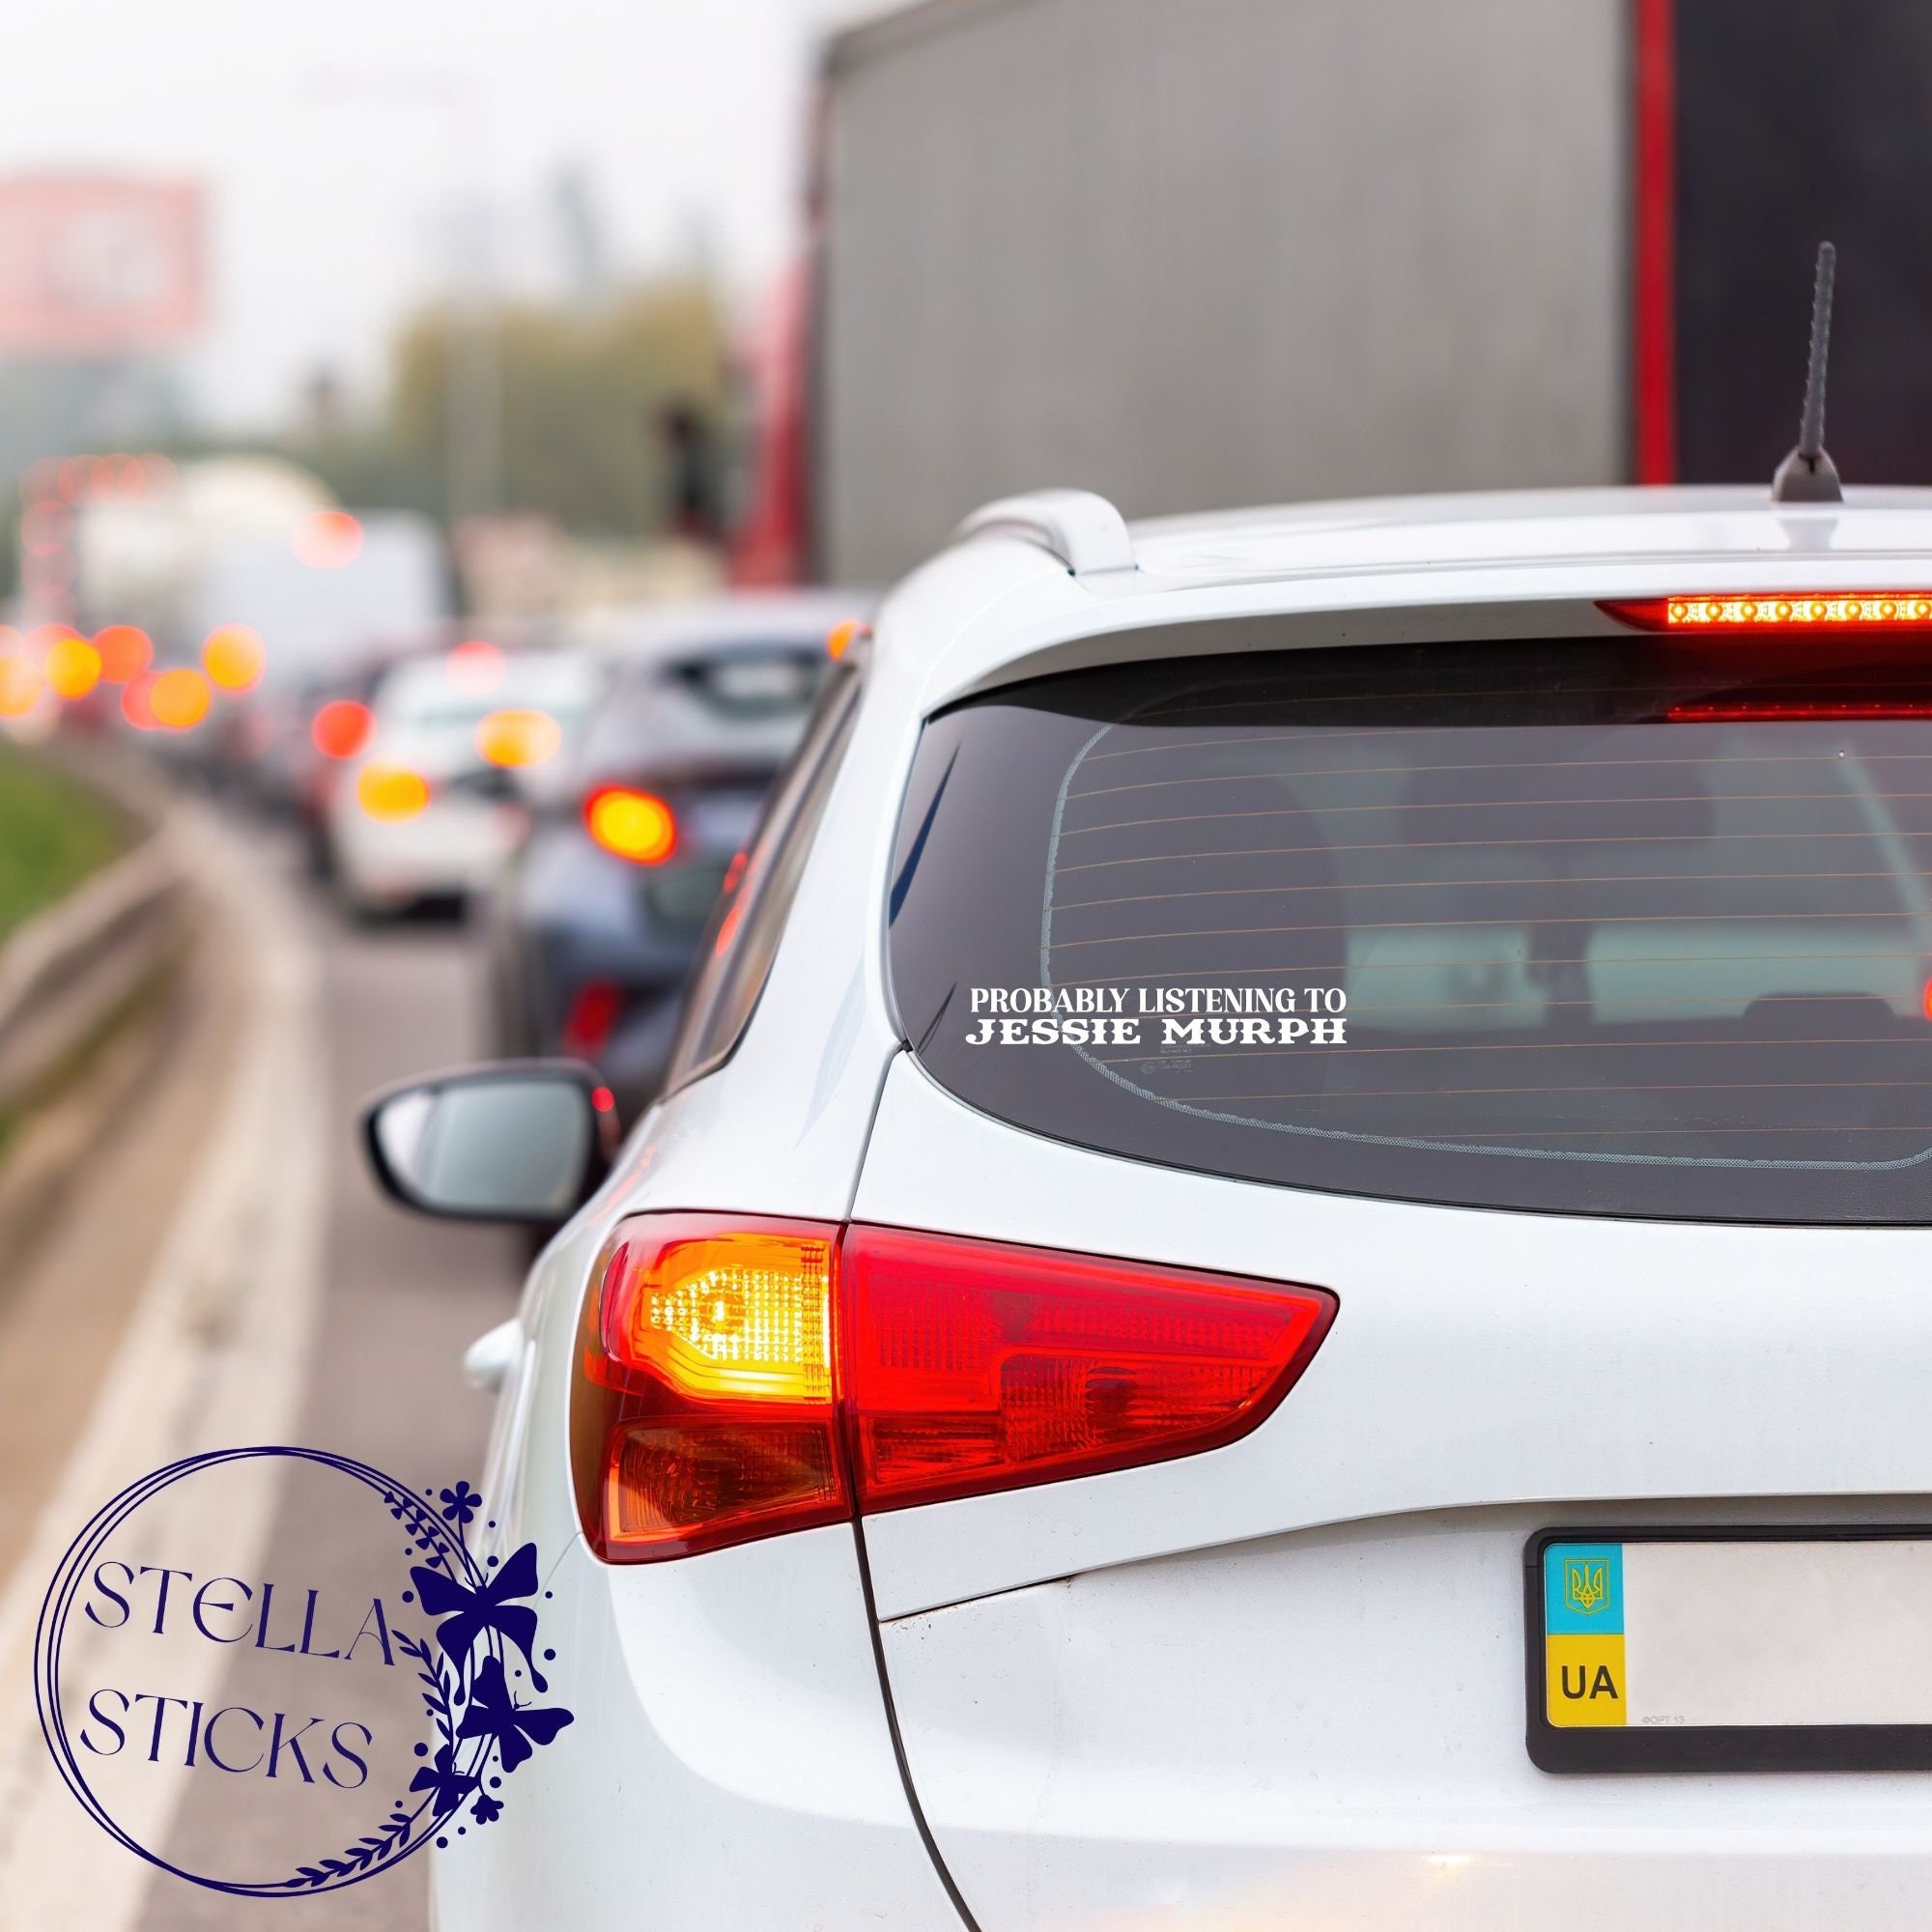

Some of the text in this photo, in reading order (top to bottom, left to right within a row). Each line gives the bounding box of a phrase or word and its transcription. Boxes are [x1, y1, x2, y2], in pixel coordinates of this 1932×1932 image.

[970, 987, 1347, 1013] PROBABLY LISTENING TO
[965, 1018, 1348, 1045] JESSIE MURPH
[1561, 1665, 1619, 1699] UA
